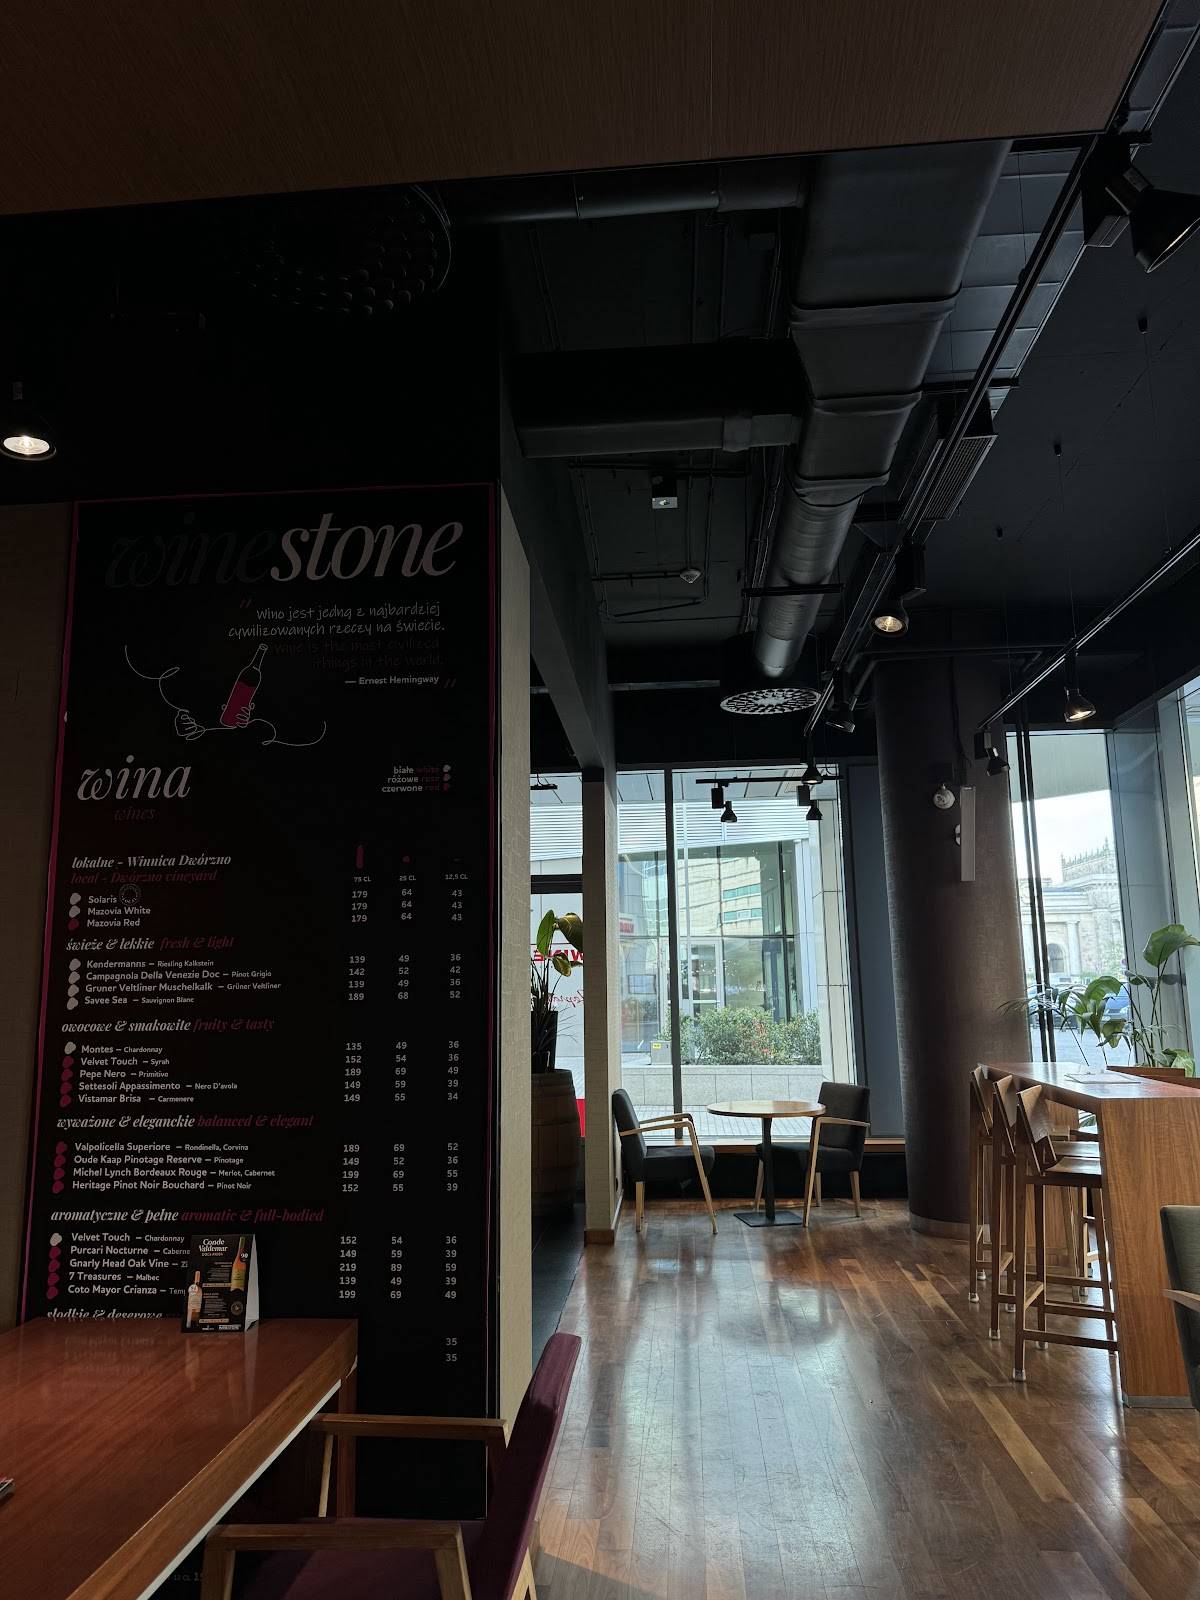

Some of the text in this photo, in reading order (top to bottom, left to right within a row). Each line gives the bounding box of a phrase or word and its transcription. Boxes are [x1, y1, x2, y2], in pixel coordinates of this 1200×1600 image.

[287, 606, 315, 622] jest
[317, 605, 352, 620] jedną
[356, 608, 365, 616] z
[370, 602, 440, 620] najbardziej
[228, 618, 444, 639] cywilizowanych rzeczy na świecie.
[390, 674, 439, 685] Hemingway
[394, 766, 414, 774] białe
[77, 755, 191, 800] wina
[72, 855, 176, 868] lokalne Winnica
[352, 890, 368, 898] 179
[402, 888, 412, 896] 64
[88, 895, 117, 904] Solaris
[352, 902, 368, 910] 179
[401, 900, 412, 908] 64
[88, 905, 151, 915] Mazovia White
[352, 914, 367, 922] 179
[401, 912, 412, 920] 64
[87, 918, 140, 927] Mazovia Red
[120, 938, 154, 950] lekkie
[350, 956, 365, 964] 139
[398, 954, 410, 962] 49
[87, 960, 146, 968] Kendermanns
[86, 969, 249, 982] Campagnola Della Venezie Doc Pinot
[349, 968, 365, 976] 142
[349, 980, 364, 988] 139
[450, 978, 460, 986] 36
[86, 982, 212, 992] Gruner Muschelkalk
[398, 992, 408, 1000] 68
[450, 990, 460, 998] 52
[84, 996, 127, 1004] Savee Sea
[62, 1019, 191, 1032] owocowe smakowite
[346, 1042, 362, 1050] 135
[448, 1040, 459, 1048] 36
[82, 1045, 162, 1054] Montes Chardonnay
[80, 1057, 138, 1066] Velvet Touch
[396, 1054, 406, 1062] 54
[448, 1054, 459, 1062] 36
[345, 1068, 361, 1076] 189
[395, 1067, 406, 1075] 69
[448, 1066, 458, 1074] 49
[80, 1070, 126, 1080] Pepe Nero
[119, 1081, 180, 1092] Appassimento
[345, 1081, 360, 1089] 149
[395, 1080, 406, 1088] 59
[448, 1079, 458, 1087] 39
[78, 1094, 141, 1102] Vistamar Brisa
[344, 1094, 360, 1102] 149
[395, 1093, 406, 1101] 55
[448, 1092, 458, 1100] 34
[133, 1115, 195, 1130] eleganckie
[75, 1142, 170, 1153] Valpolicella Superiore
[344, 1144, 360, 1152] 189
[394, 1144, 404, 1152] 69
[448, 1142, 458, 1150] 52
[74, 1155, 244, 1166] Oude Kaap Pinotage Reserve Pinotage
[343, 1158, 359, 1166] 149
[394, 1157, 404, 1165] 52
[448, 1156, 458, 1164] 36
[73, 1168, 207, 1178] Michel Lynch Bordeaux Rouge
[342, 1170, 359, 1178] 199
[393, 1170, 404, 1178] 69
[447, 1170, 458, 1178] 55
[72, 1180, 111, 1192] Heritage
[113, 1180, 138, 1189] Pinot
[140, 1180, 160, 1189] Noir
[162, 1180, 204, 1189] Bouchard
[342, 1184, 358, 1192] 152
[393, 1184, 404, 1192] 55
[447, 1183, 458, 1191] 39
[51, 1210, 128, 1223] aromatyczne
[72, 1232, 184, 1243] Velvet Touch Chardonnay
[340, 1236, 356, 1244] 152
[392, 1236, 402, 1244] 54
[446, 1236, 456, 1244] 36
[70, 1245, 148, 1254] Purcari Nocturne
[340, 1250, 356, 1258] 149
[391, 1250, 402, 1258] 59
[446, 1250, 456, 1258] 39
[70, 1258, 100, 1270] Gnarly
[102, 1259, 125, 1267] Head
[128, 1258, 146, 1268] Oak
[148, 1258, 169, 1268] Vine
[340, 1263, 356, 1271] 219
[391, 1264, 402, 1272] 89
[446, 1263, 456, 1271] 59
[69, 1272, 75, 1280] 7
[77, 1272, 121, 1280] Treasures
[340, 1276, 356, 1285] 139
[390, 1277, 402, 1285] 49
[445, 1277, 456, 1285] 39
[68, 1285, 157, 1296] Coto Mayor Crianza
[339, 1290, 356, 1298] 199
[390, 1290, 402, 1299] 69
[446, 1338, 458, 1346] 35
[446, 1354, 457, 1362] 35
